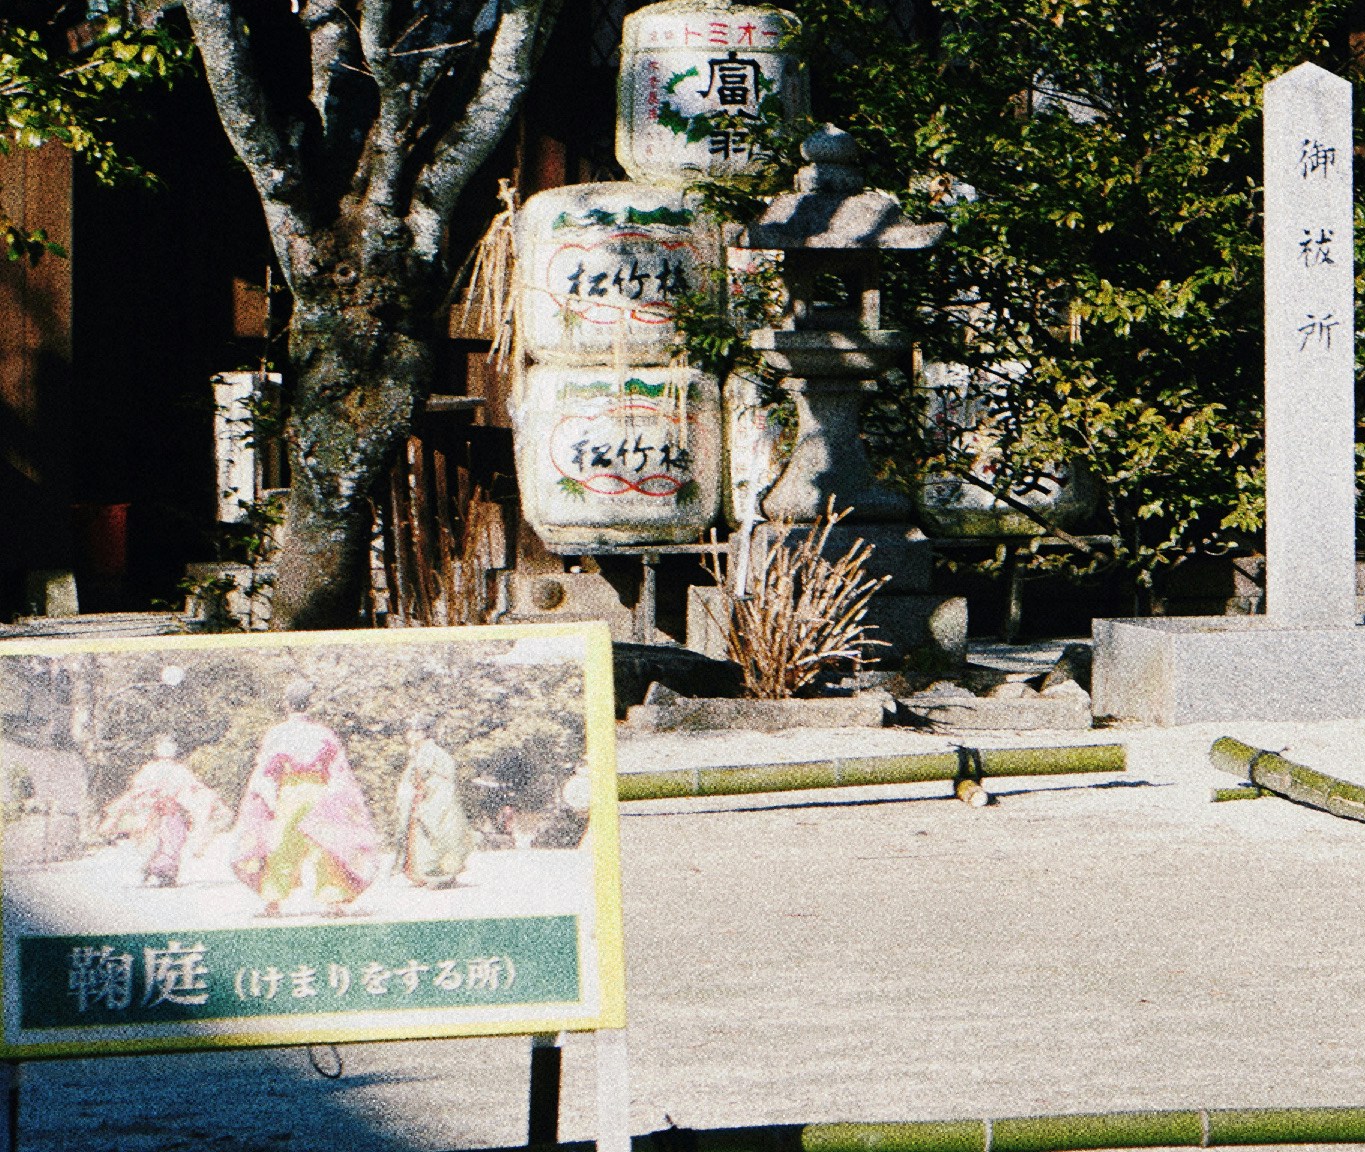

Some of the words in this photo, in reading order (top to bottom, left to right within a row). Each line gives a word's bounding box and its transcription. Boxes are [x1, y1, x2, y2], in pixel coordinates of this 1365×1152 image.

[683, 21, 780, 46] トミオー
[1297, 138, 1340, 352] 御祓所
[567, 258, 691, 300] 松竹梅
[570, 431, 695, 473] 松竹梅
[234, 954, 517, 1000] (けまりをする所)
